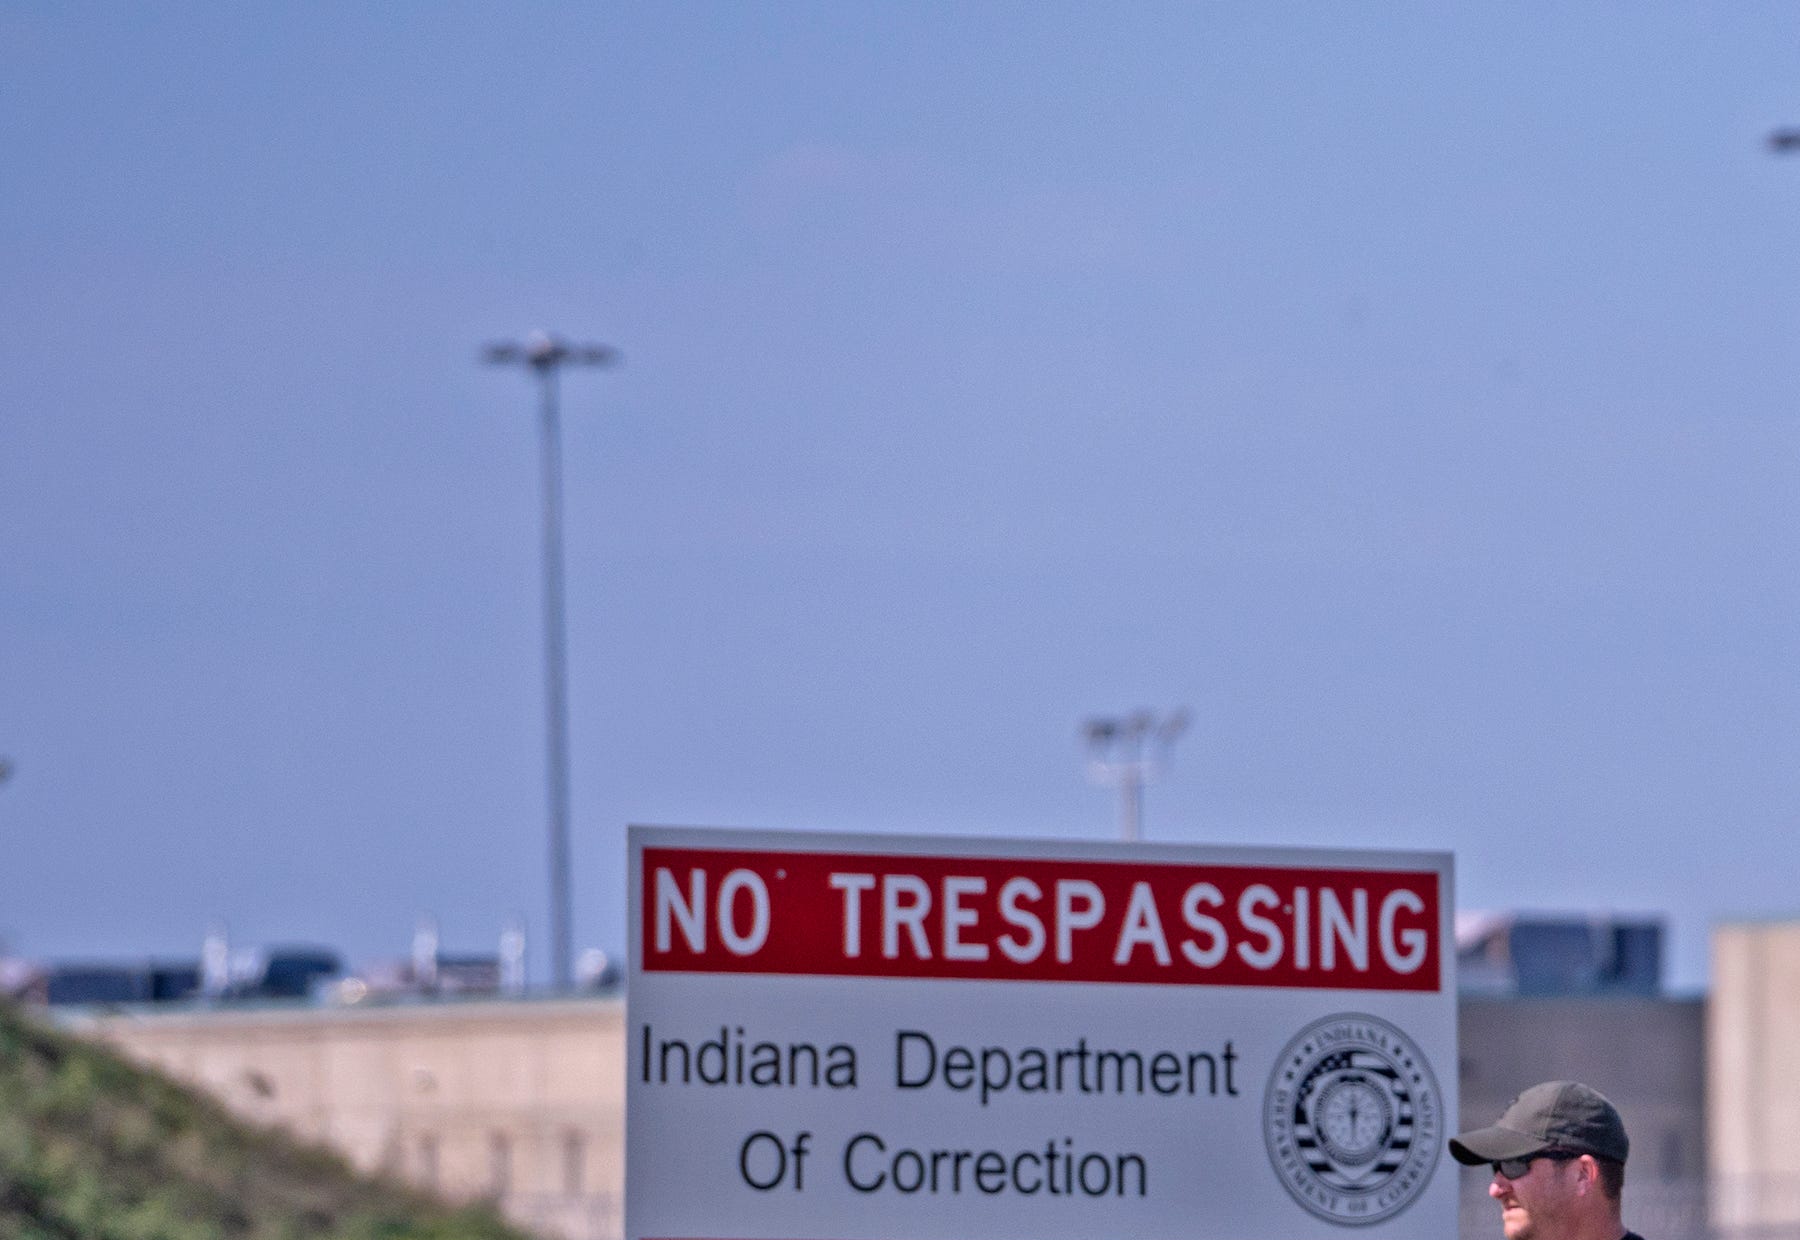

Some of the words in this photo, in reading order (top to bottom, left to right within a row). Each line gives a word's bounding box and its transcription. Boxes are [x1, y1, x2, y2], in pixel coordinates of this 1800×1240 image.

[656, 867, 772, 956] NO
[829, 872, 1428, 973] TRESPASSING
[640, 1024, 858, 1090] Indiana
[894, 1030, 1239, 1106] Department
[738, 1131, 812, 1194] Of
[842, 1132, 1148, 1198] Correction
